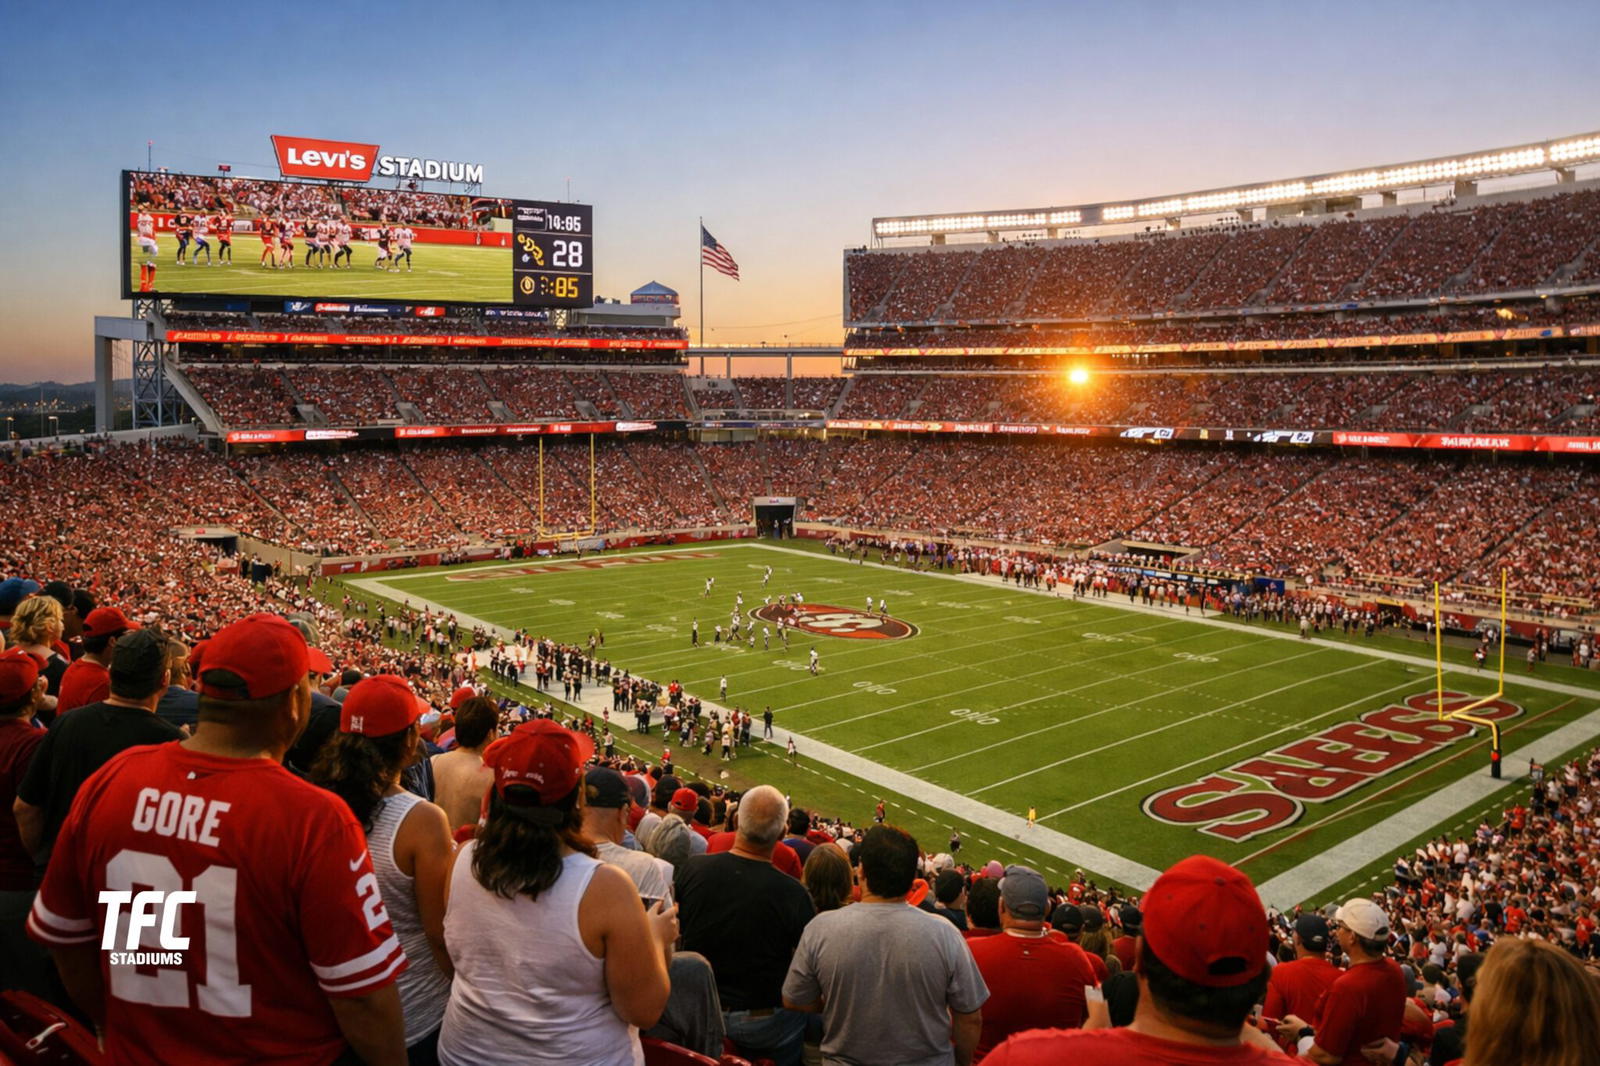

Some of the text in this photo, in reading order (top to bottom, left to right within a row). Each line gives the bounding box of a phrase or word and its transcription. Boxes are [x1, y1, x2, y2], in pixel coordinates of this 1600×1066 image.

[287, 147, 484, 183] Levi's STADIUM
[552, 240, 583, 268] 28
[132, 787, 231, 847] GORE
[355, 872, 390, 931] 2
[106, 849, 252, 1017] 21
